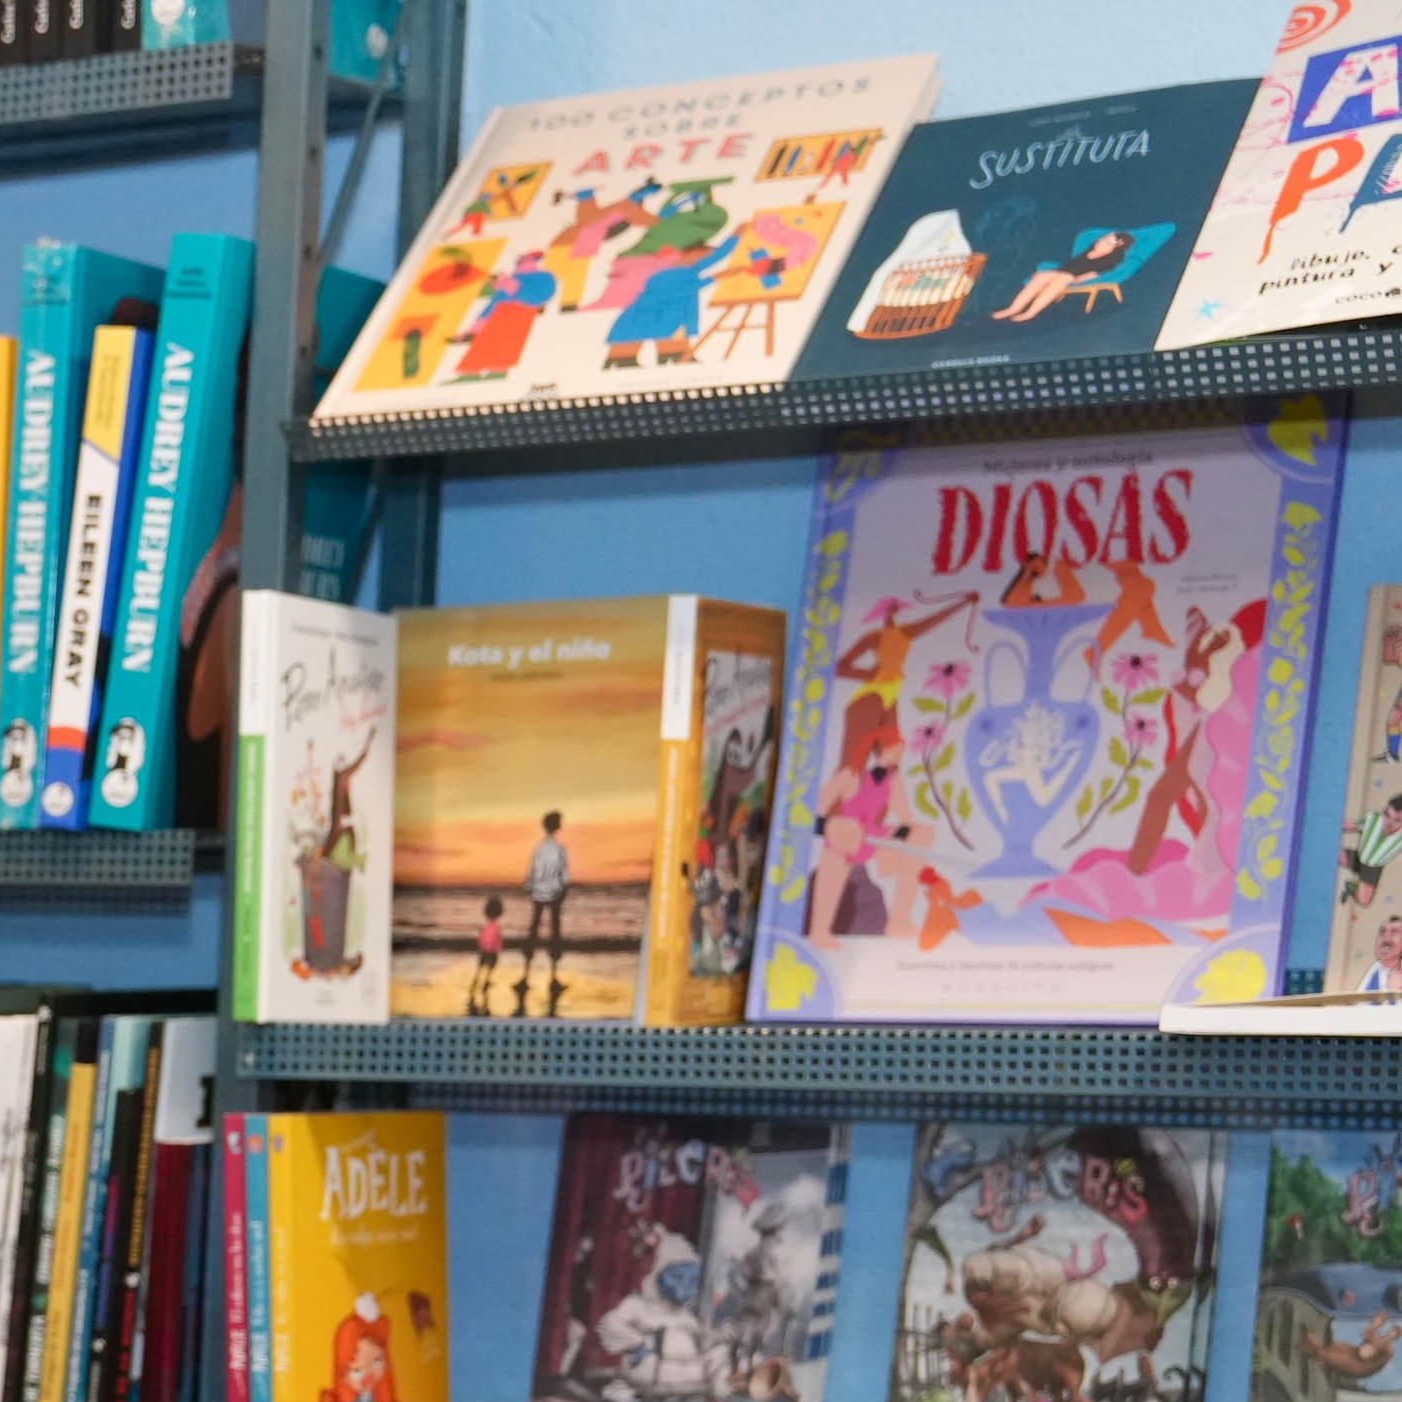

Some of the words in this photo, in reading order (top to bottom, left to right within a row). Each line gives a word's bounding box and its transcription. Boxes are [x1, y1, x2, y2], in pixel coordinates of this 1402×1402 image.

[608, 77, 870, 123] CONCEPTOS
[622, 113, 743, 139] SOBRE
[571, 133, 753, 177] ARTE
[969, 128, 1151, 190] SUSTITUTA
[20, 350, 56, 494] AUDREY
[147, 342, 194, 493] AUDREY
[75, 494, 103, 598] EILEEN
[932, 467, 1193, 577] DIOSAS
[8, 501, 48, 674] HEPBURN
[121, 496, 175, 673] HEPBURN
[65, 607, 91, 689] GRAY
[448, 643, 504, 667] Kota
[508, 647, 524, 670] y
[528, 636, 554, 663] el
[557, 635, 612, 661] niño
